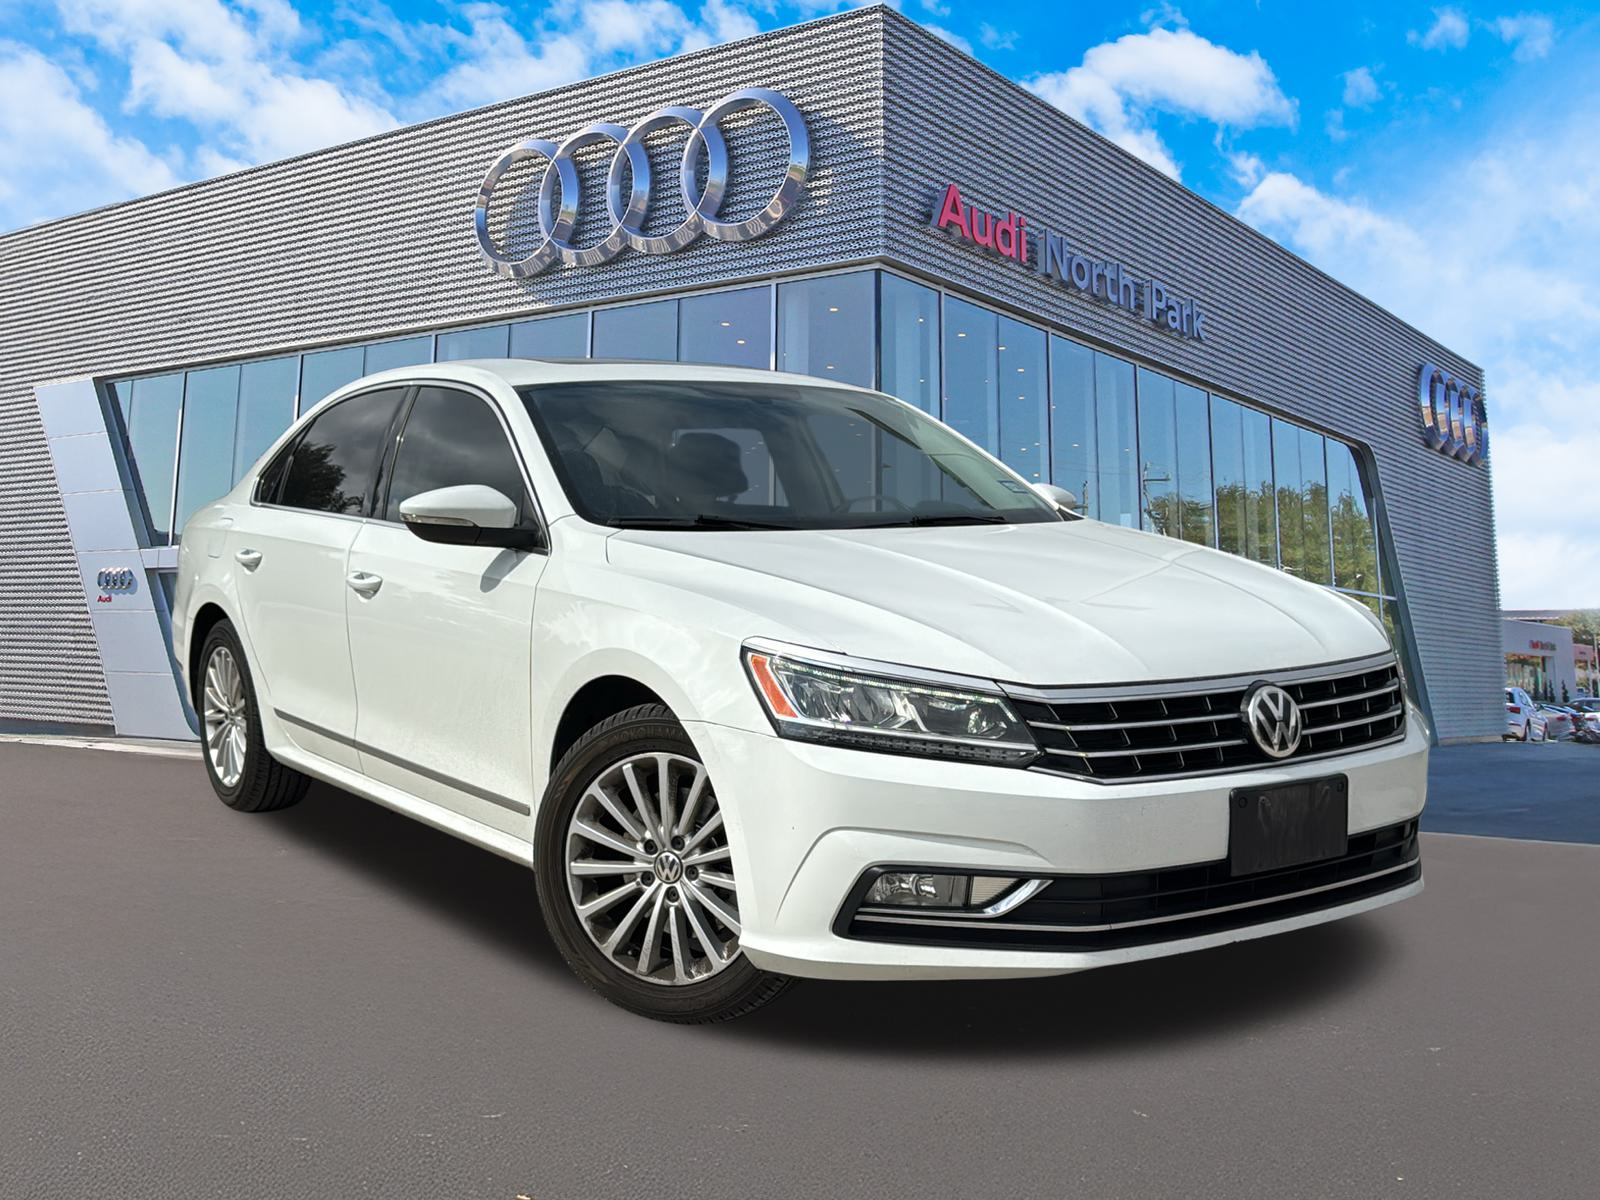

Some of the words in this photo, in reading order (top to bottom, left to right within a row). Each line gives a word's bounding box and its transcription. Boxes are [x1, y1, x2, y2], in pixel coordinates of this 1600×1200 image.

[934, 183, 1027, 263] Audi
[1042, 229, 1138, 311] North
[1147, 279, 1206, 341] Park
[1250, 686, 1301, 757] VW
[656, 852, 682, 883] VW
